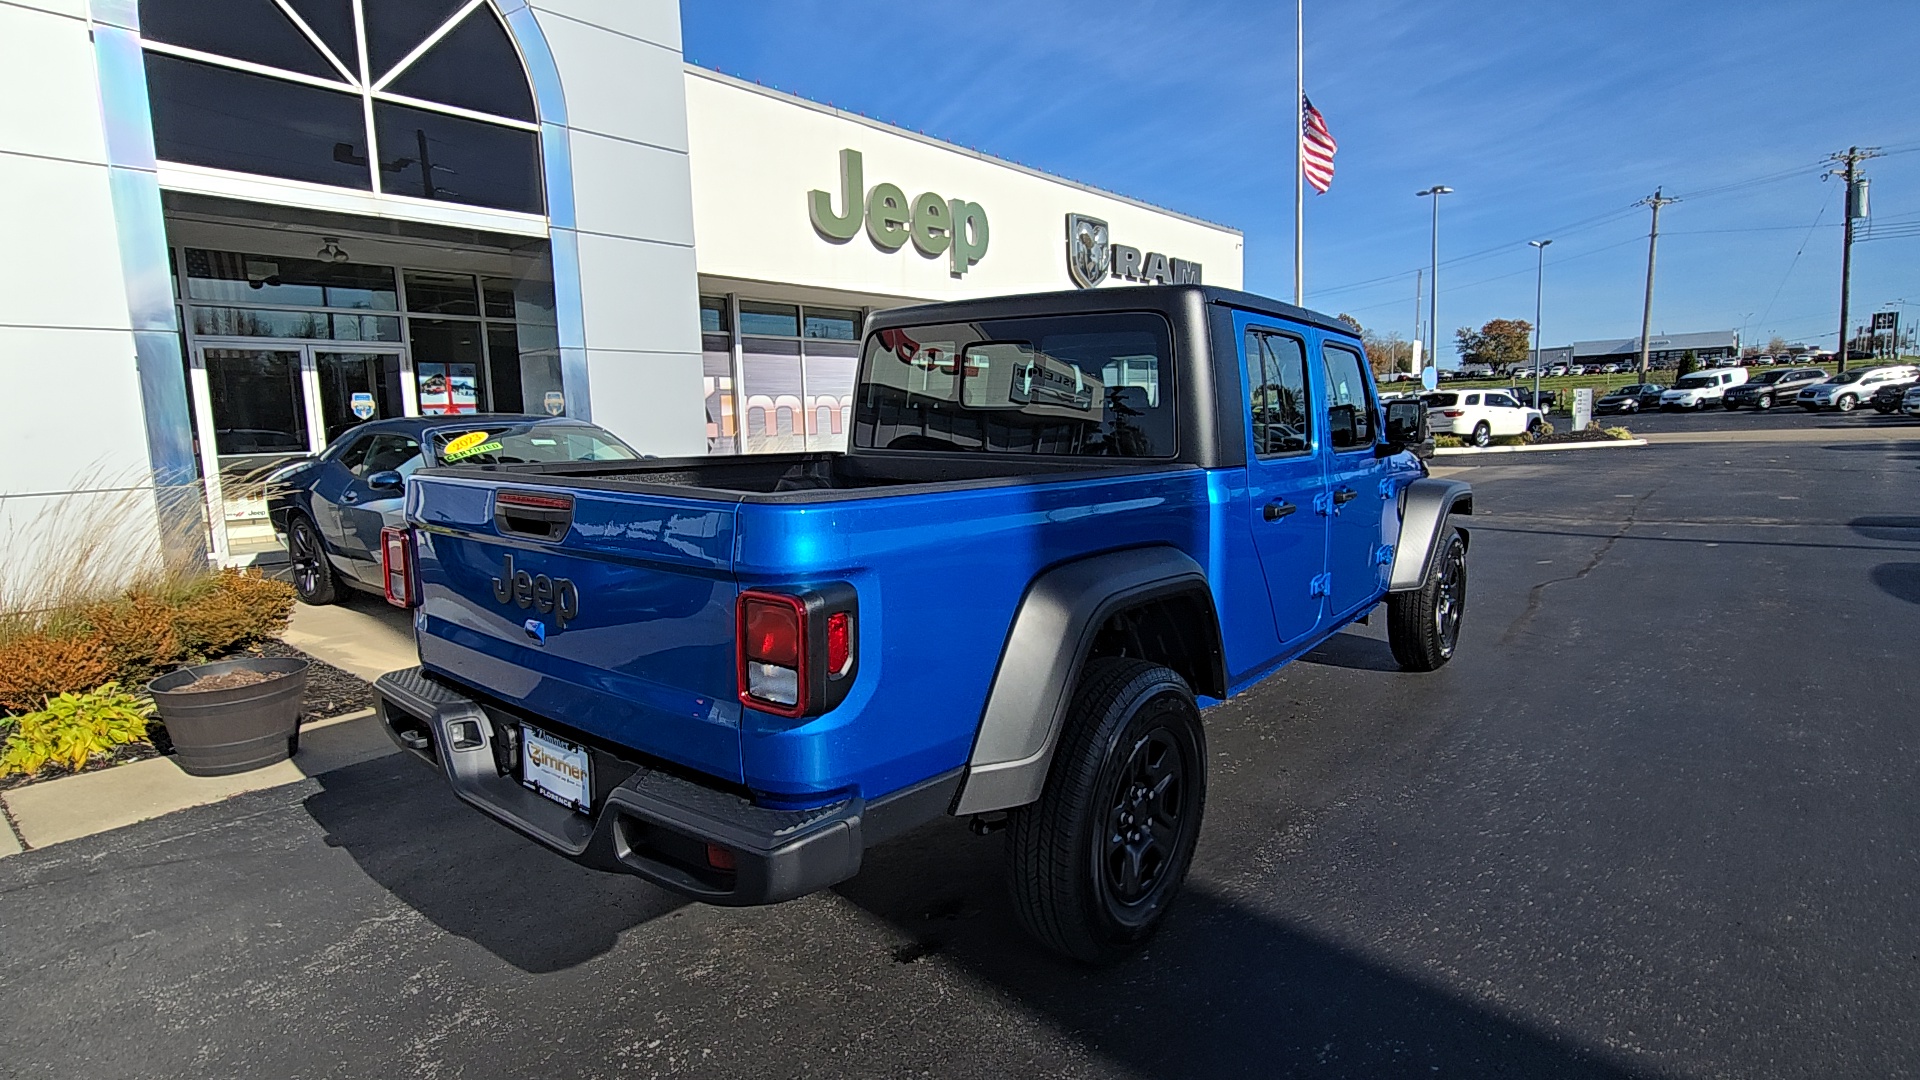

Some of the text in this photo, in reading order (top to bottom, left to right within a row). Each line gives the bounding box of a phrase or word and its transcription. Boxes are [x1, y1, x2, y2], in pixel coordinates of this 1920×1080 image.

[808, 148, 989, 277] Jeep
[1110, 243, 1203, 285] RAM
[446, 443, 499, 461] CERTIFIED
[452, 433, 483, 451] 2023
[492, 553, 579, 630] Jeep
